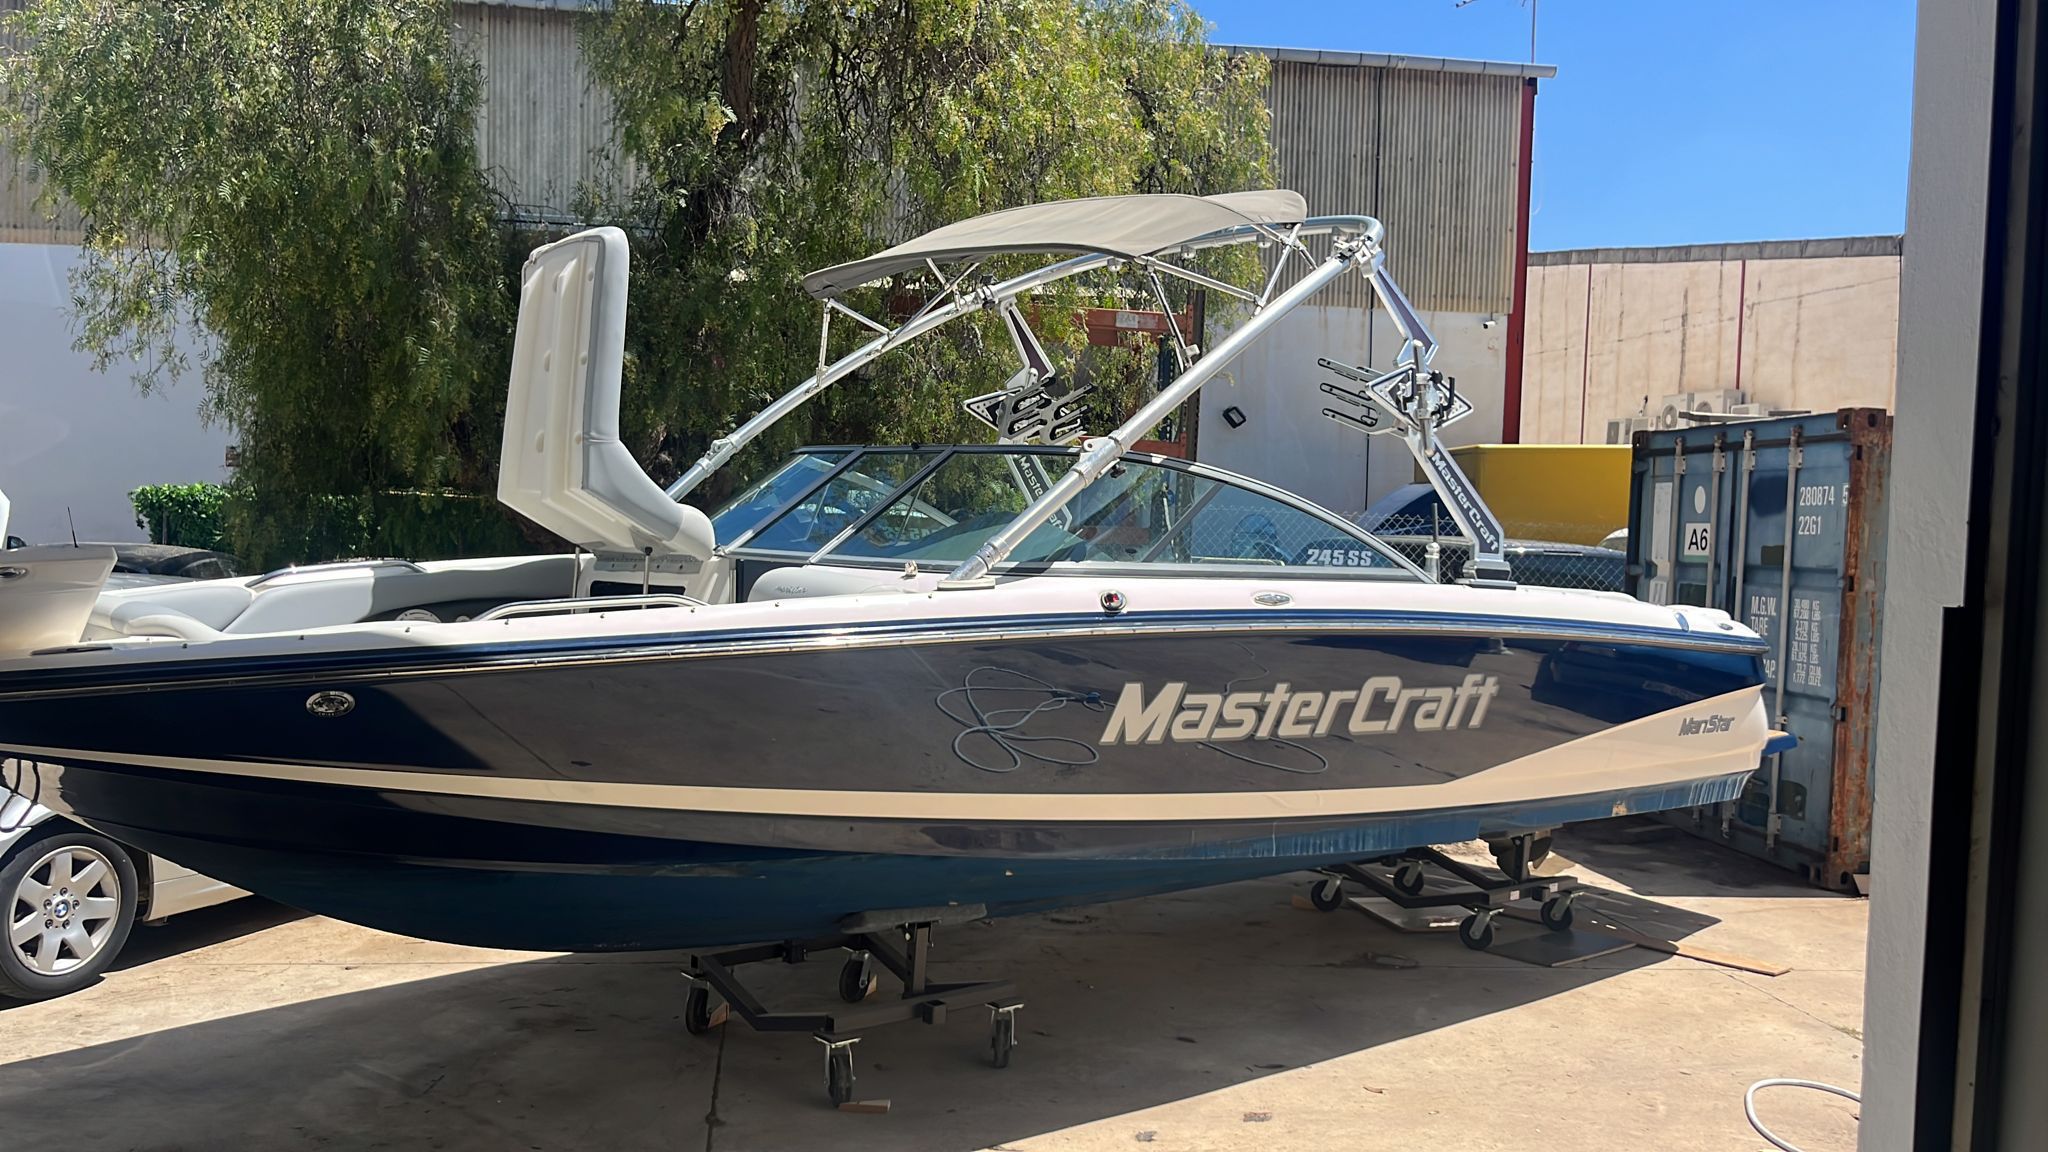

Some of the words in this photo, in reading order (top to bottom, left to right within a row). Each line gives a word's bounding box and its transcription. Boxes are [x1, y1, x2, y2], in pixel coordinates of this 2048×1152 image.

[1432, 452, 1498, 551] MasterCraft
[1800, 486, 1834, 506] 280874
[1842, 484, 1849, 505] 5
[1798, 515, 1821, 535] 22G1
[1688, 528, 1708, 551] A6
[1306, 549, 1344, 566] 245
[1347, 550, 1371, 566] SS
[1750, 616, 1769, 636] TARE
[1763, 659, 1776, 678] AP.
[1099, 674, 1500, 745] MasterCraft
